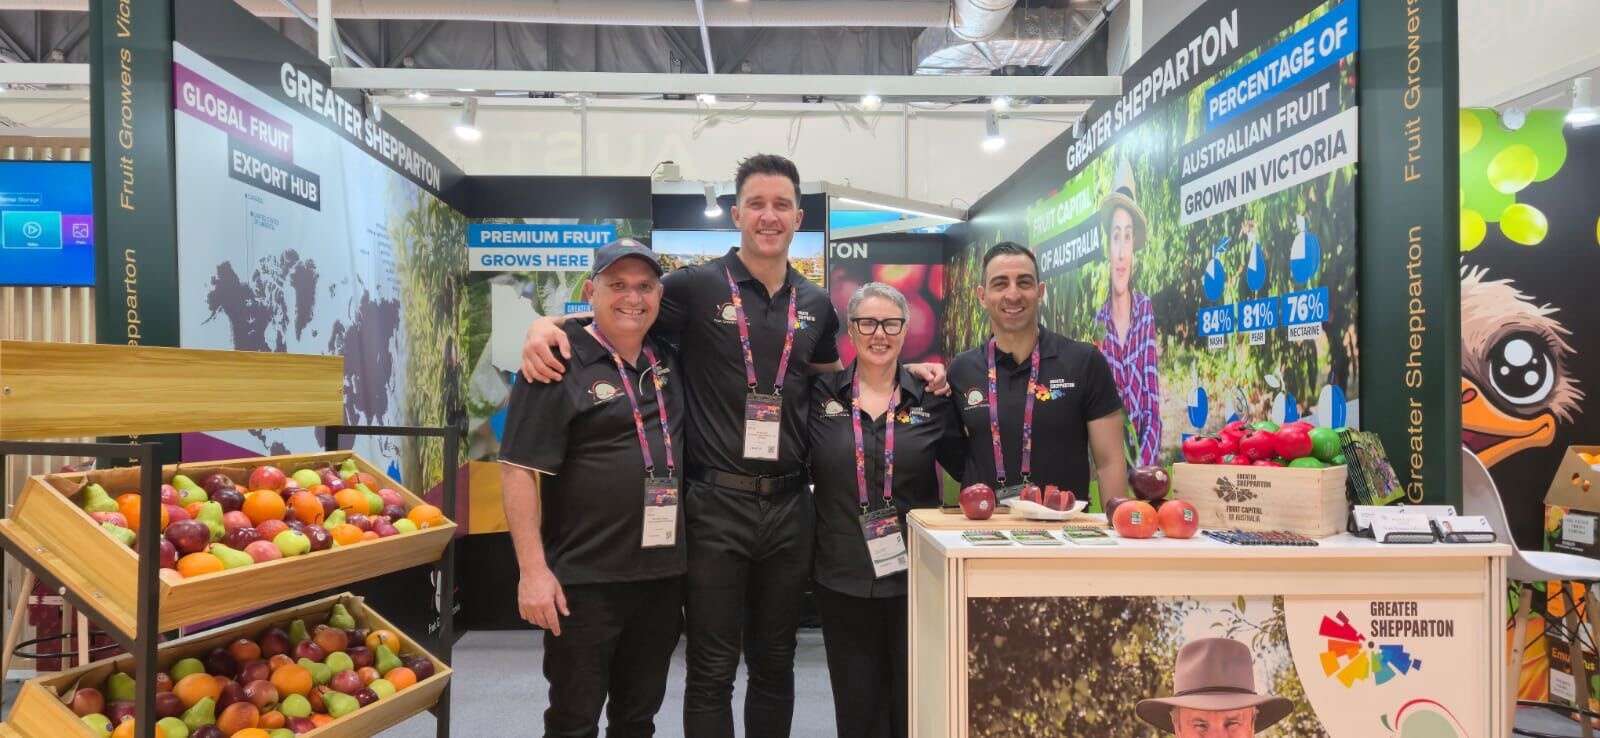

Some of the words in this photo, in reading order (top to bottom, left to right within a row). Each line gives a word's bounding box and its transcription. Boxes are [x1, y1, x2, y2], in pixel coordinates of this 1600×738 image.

[118, 48, 135, 150] Growers
[1066, 117, 1113, 172] GREATER
[1113, 8, 1239, 129] SHEPPARTON
[1208, 44, 1316, 122] PERCENTAGE
[1319, 18, 1350, 58] OF
[182, 82, 247, 133] GLOBAL
[250, 117, 291, 153] FRUIT
[280, 61, 364, 140] GREATER
[364, 121, 441, 192] SHEPPARTON
[1181, 113, 1273, 179] AUSTRALIAN
[1276, 82, 1331, 134] FRUIT
[233, 149, 288, 191] EXPORT
[290, 174, 318, 203] HUB
[1184, 170, 1238, 217] GROWN
[1241, 165, 1257, 196] IN
[1260, 128, 1348, 188] VICTORIA
[1404, 117, 1422, 184] Fruit
[119, 156, 137, 212] Fruit
[480, 230, 558, 244] PREMIUM
[562, 231, 611, 244] FRUIT
[480, 254, 542, 267] GROWS
[546, 254, 589, 267] HERE
[1041, 250, 1052, 273] OF
[1052, 225, 1100, 268] AUSTRALIA
[127, 248, 142, 350] epparton
[1202, 308, 1232, 334] 84%
[1243, 302, 1274, 328] 81%
[1287, 291, 1324, 321] 76%
[1406, 225, 1426, 389] Shepparton
[1289, 325, 1320, 338] NECTARINE
[1405, 397, 1424, 504] Greater
[1370, 601, 1418, 617] GREATER
[1370, 619, 1455, 638] SHEPPARTON
